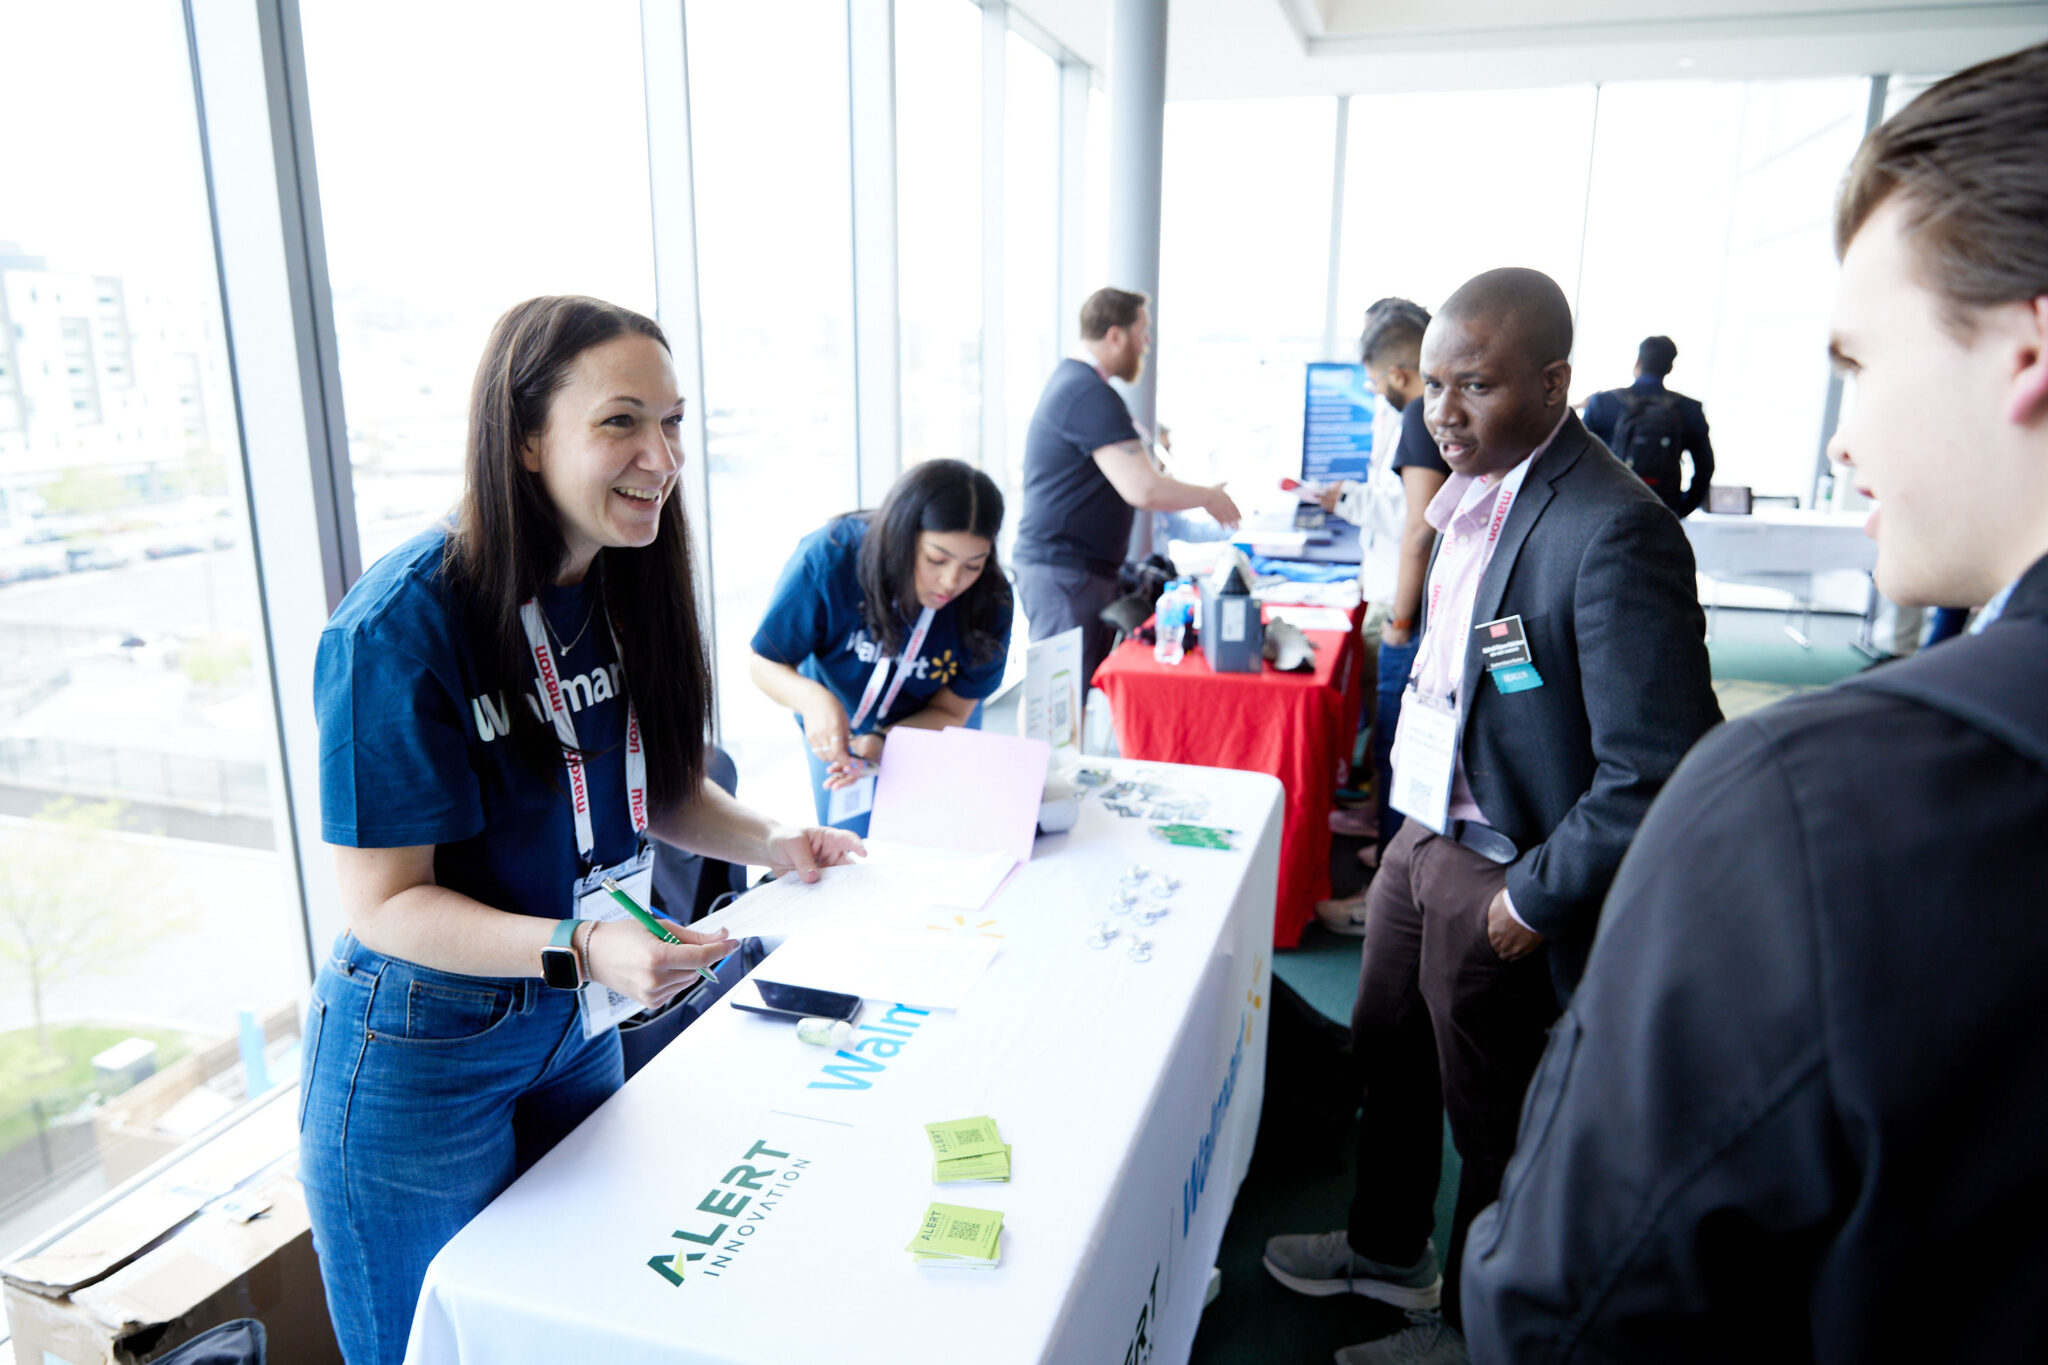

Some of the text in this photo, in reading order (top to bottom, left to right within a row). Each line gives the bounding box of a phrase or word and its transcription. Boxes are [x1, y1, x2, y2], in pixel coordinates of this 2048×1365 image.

[1488, 490, 1513, 542] maxon
[534, 644, 564, 713] maxon
[631, 788, 646, 831] max
[647, 1139, 791, 1288] ALERT
[703, 1158, 812, 1277] INNOVATION
[921, 1210, 942, 1241] ALERT
